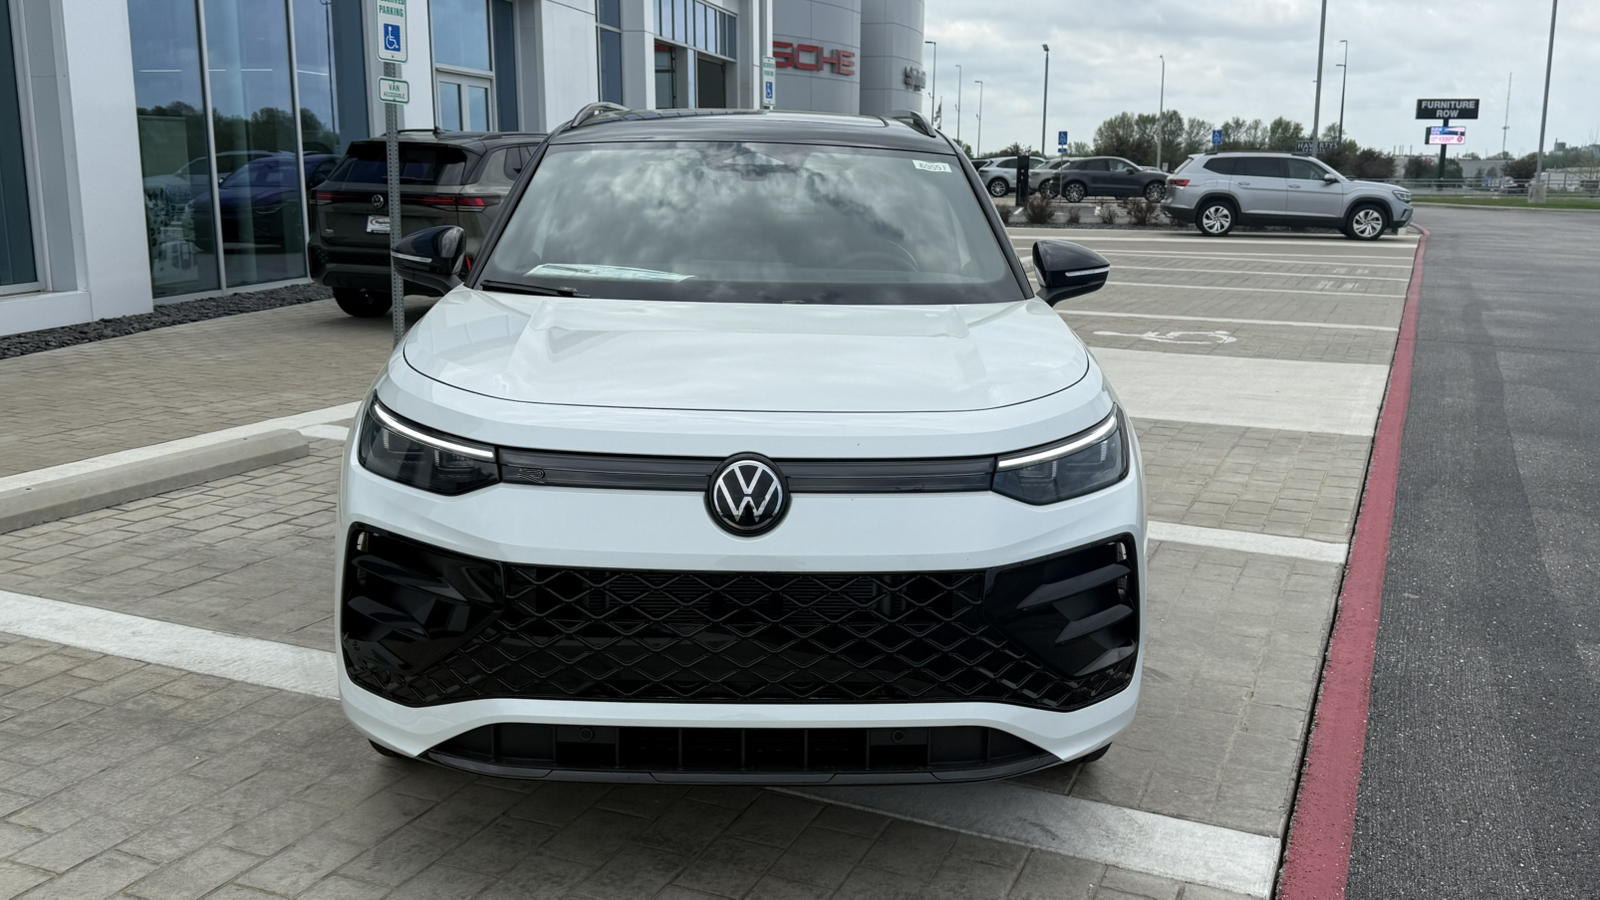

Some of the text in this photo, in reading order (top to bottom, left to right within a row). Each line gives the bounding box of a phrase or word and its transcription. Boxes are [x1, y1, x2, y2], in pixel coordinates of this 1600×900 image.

[379, 5, 403, 17] PARKING
[388, 83, 400, 92] VAN
[1421, 101, 1475, 109] FURNITURE
[1436, 110, 1459, 118] ROW
[714, 460, 782, 529] VW
